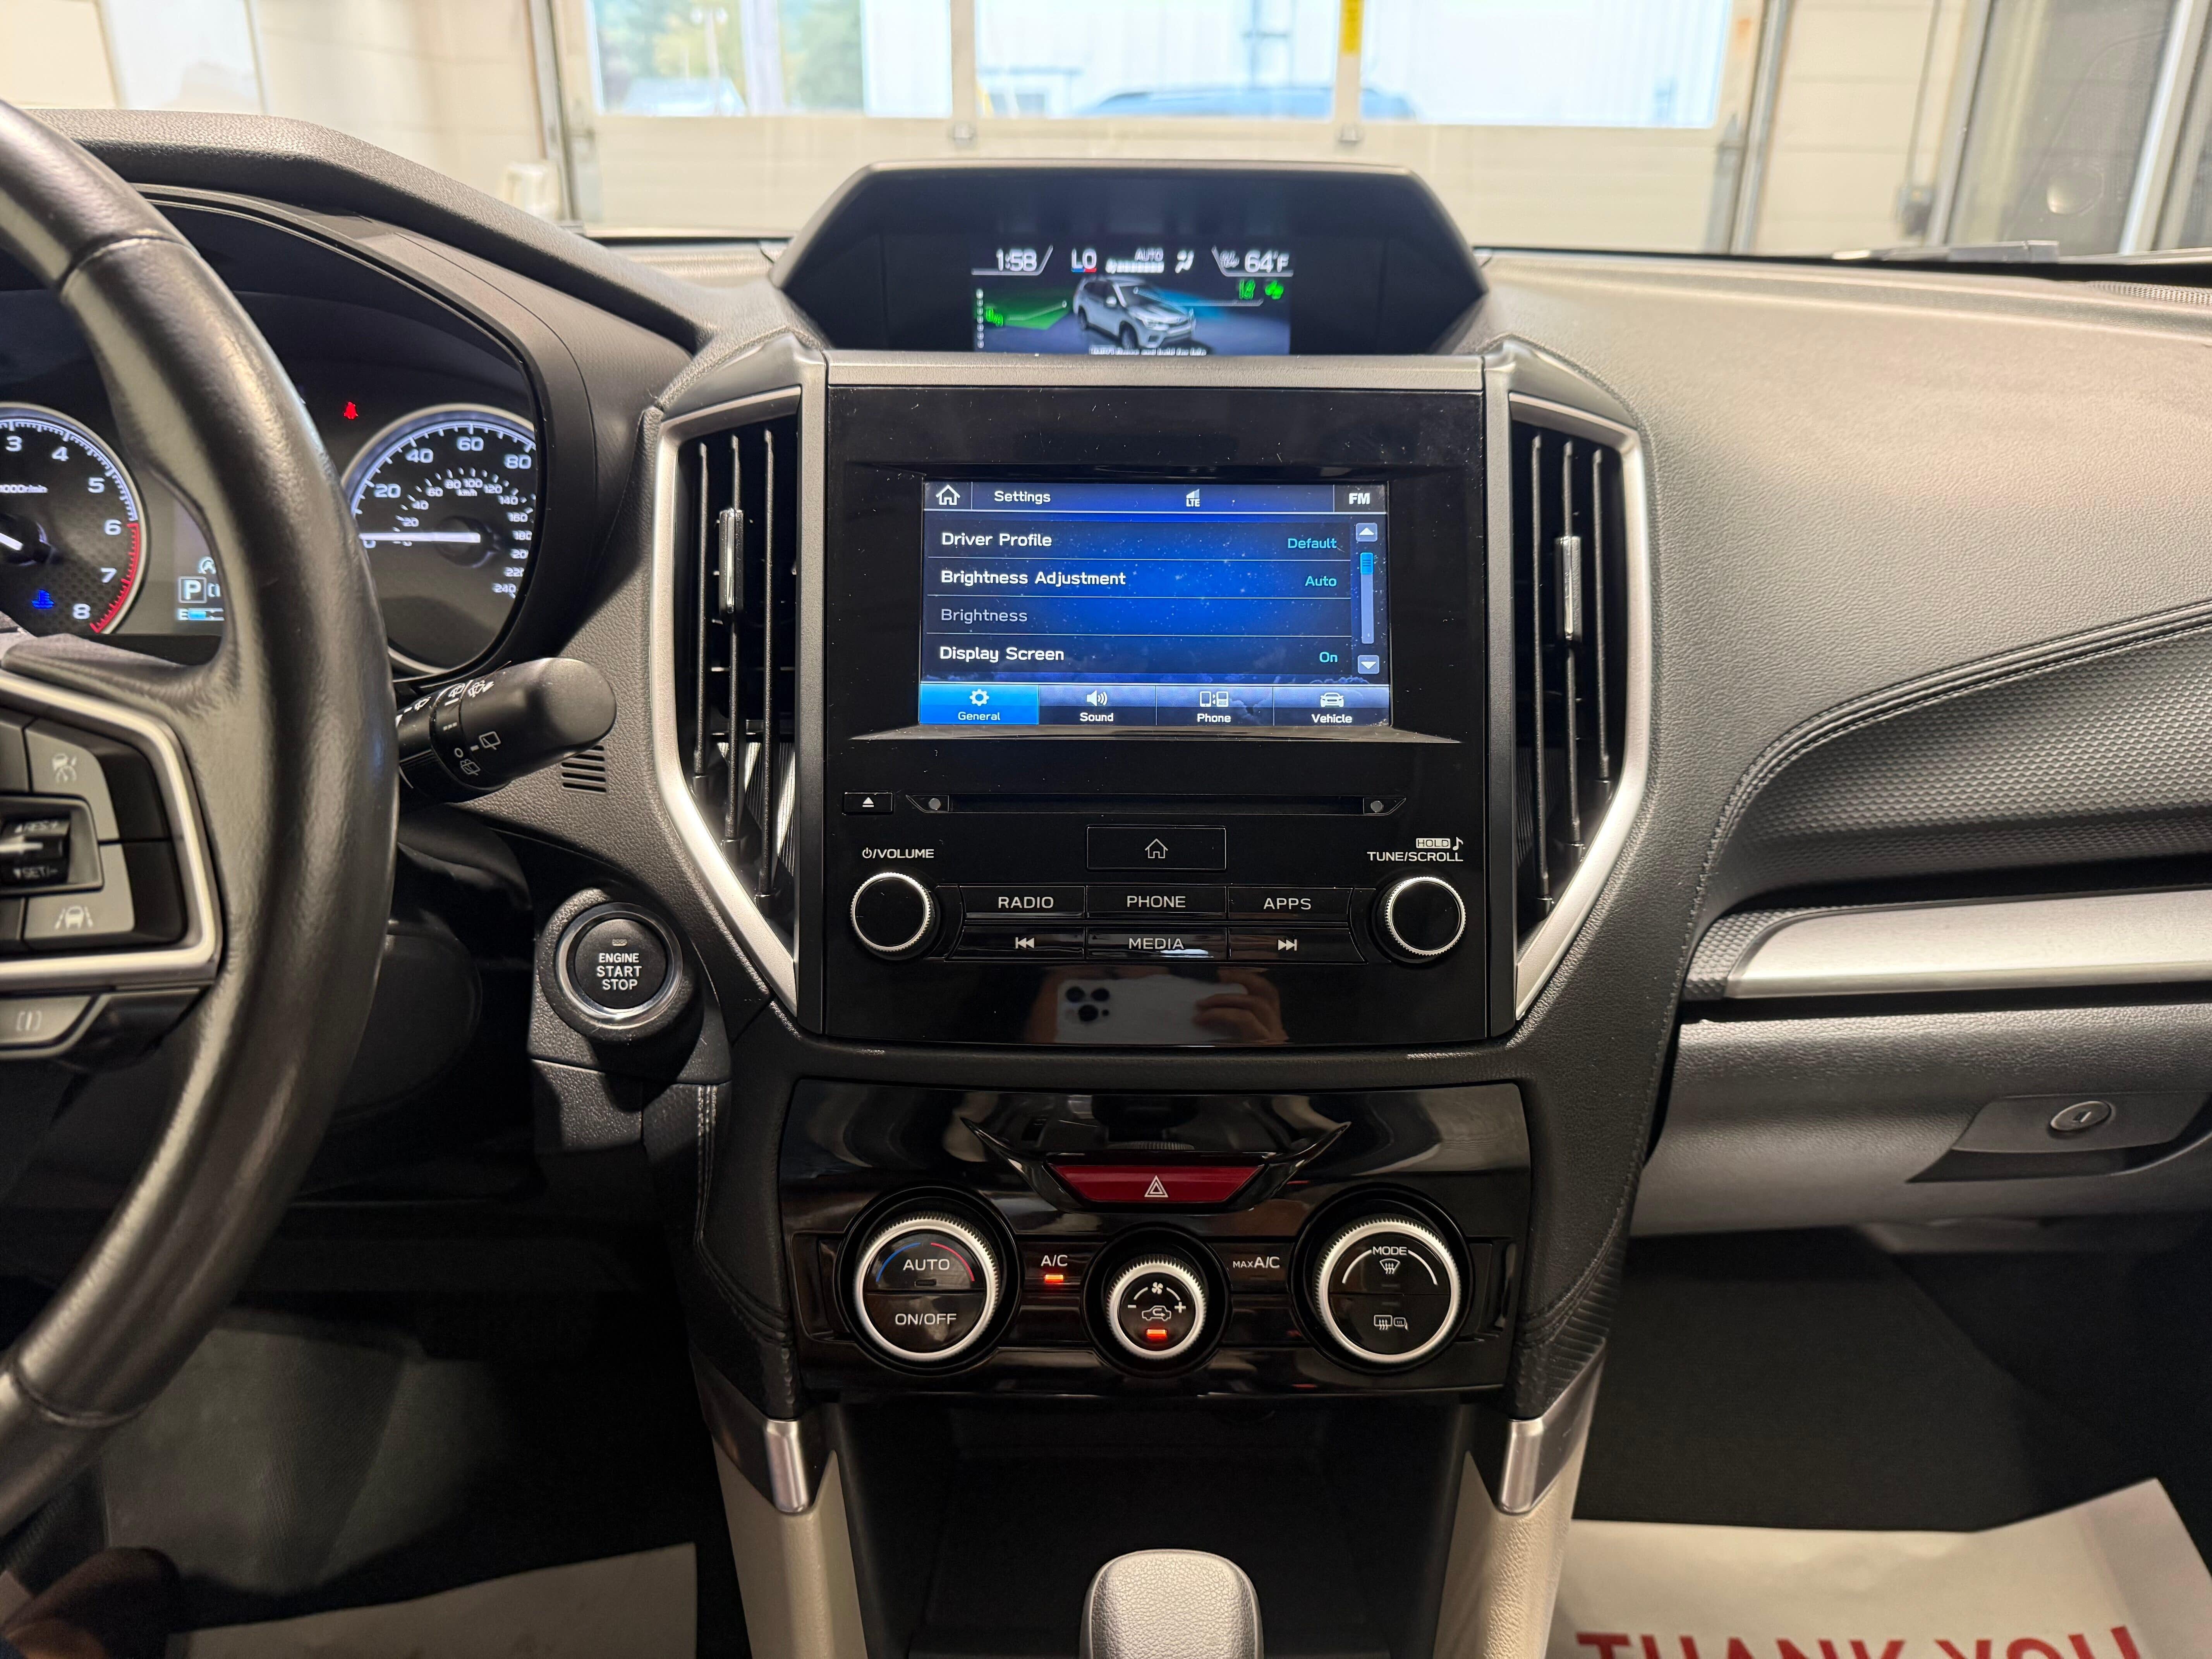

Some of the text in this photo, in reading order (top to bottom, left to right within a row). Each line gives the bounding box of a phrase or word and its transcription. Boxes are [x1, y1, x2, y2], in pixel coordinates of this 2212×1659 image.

[996, 249, 1037, 271] 1:58
[1071, 248, 1097, 269] LO
[1135, 248, 1164, 262] AUTO
[6, 436, 22, 452] 3
[457, 436, 484, 451] 60
[52, 447, 68, 461] 4
[405, 448, 433, 463] 40
[504, 454, 531, 469] 80
[88, 477, 105, 493] 5
[463, 478, 483, 488] 100
[483, 484, 503, 494] 120
[373, 484, 401, 498] 20
[498, 495, 519, 505] 140
[994, 491, 1051, 505] Settings
[1186, 498, 1200, 507] LTE
[1349, 493, 1370, 505] FM
[402, 517, 419, 527] 20
[507, 512, 528, 522] 160
[105, 519, 122, 535] 6
[942, 532, 1052, 546] Driver Profile
[1288, 538, 1337, 549] Default
[510, 549, 529, 559] 20
[100, 568, 117, 583] 7
[941, 570, 1127, 587] Brightness Adjustment
[1305, 575, 1337, 587] Auto
[184, 580, 201, 600] P
[492, 583, 516, 592] 240
[72, 603, 91, 619] 8
[178, 608, 189, 620] E
[941, 608, 1027, 624] Brightness
[940, 646, 1064, 663] Display Screen
[1319, 652, 1338, 663] On
[957, 710, 1002, 722] General
[1080, 712, 1114, 722] Sound
[1197, 713, 1231, 723] Phone
[1311, 714, 1352, 723] Vehicle
[1367, 852, 1464, 862] TUNE/SCROLL
[998, 896, 1054, 908] RADIO
[1127, 895, 1186, 908] PHONE
[1264, 898, 1311, 910] APPS
[1128, 938, 1184, 950] MEDIA
[599, 953, 639, 963] ENGINE
[596, 965, 642, 977] START
[602, 979, 638, 991] STOP
[1373, 1246, 1407, 1256] MODE
[903, 1259, 950, 1271] AUTO
[1041, 1254, 1068, 1267] A/C
[1254, 1256, 1280, 1269] A/C
[895, 1313, 957, 1325] ON/OFF
